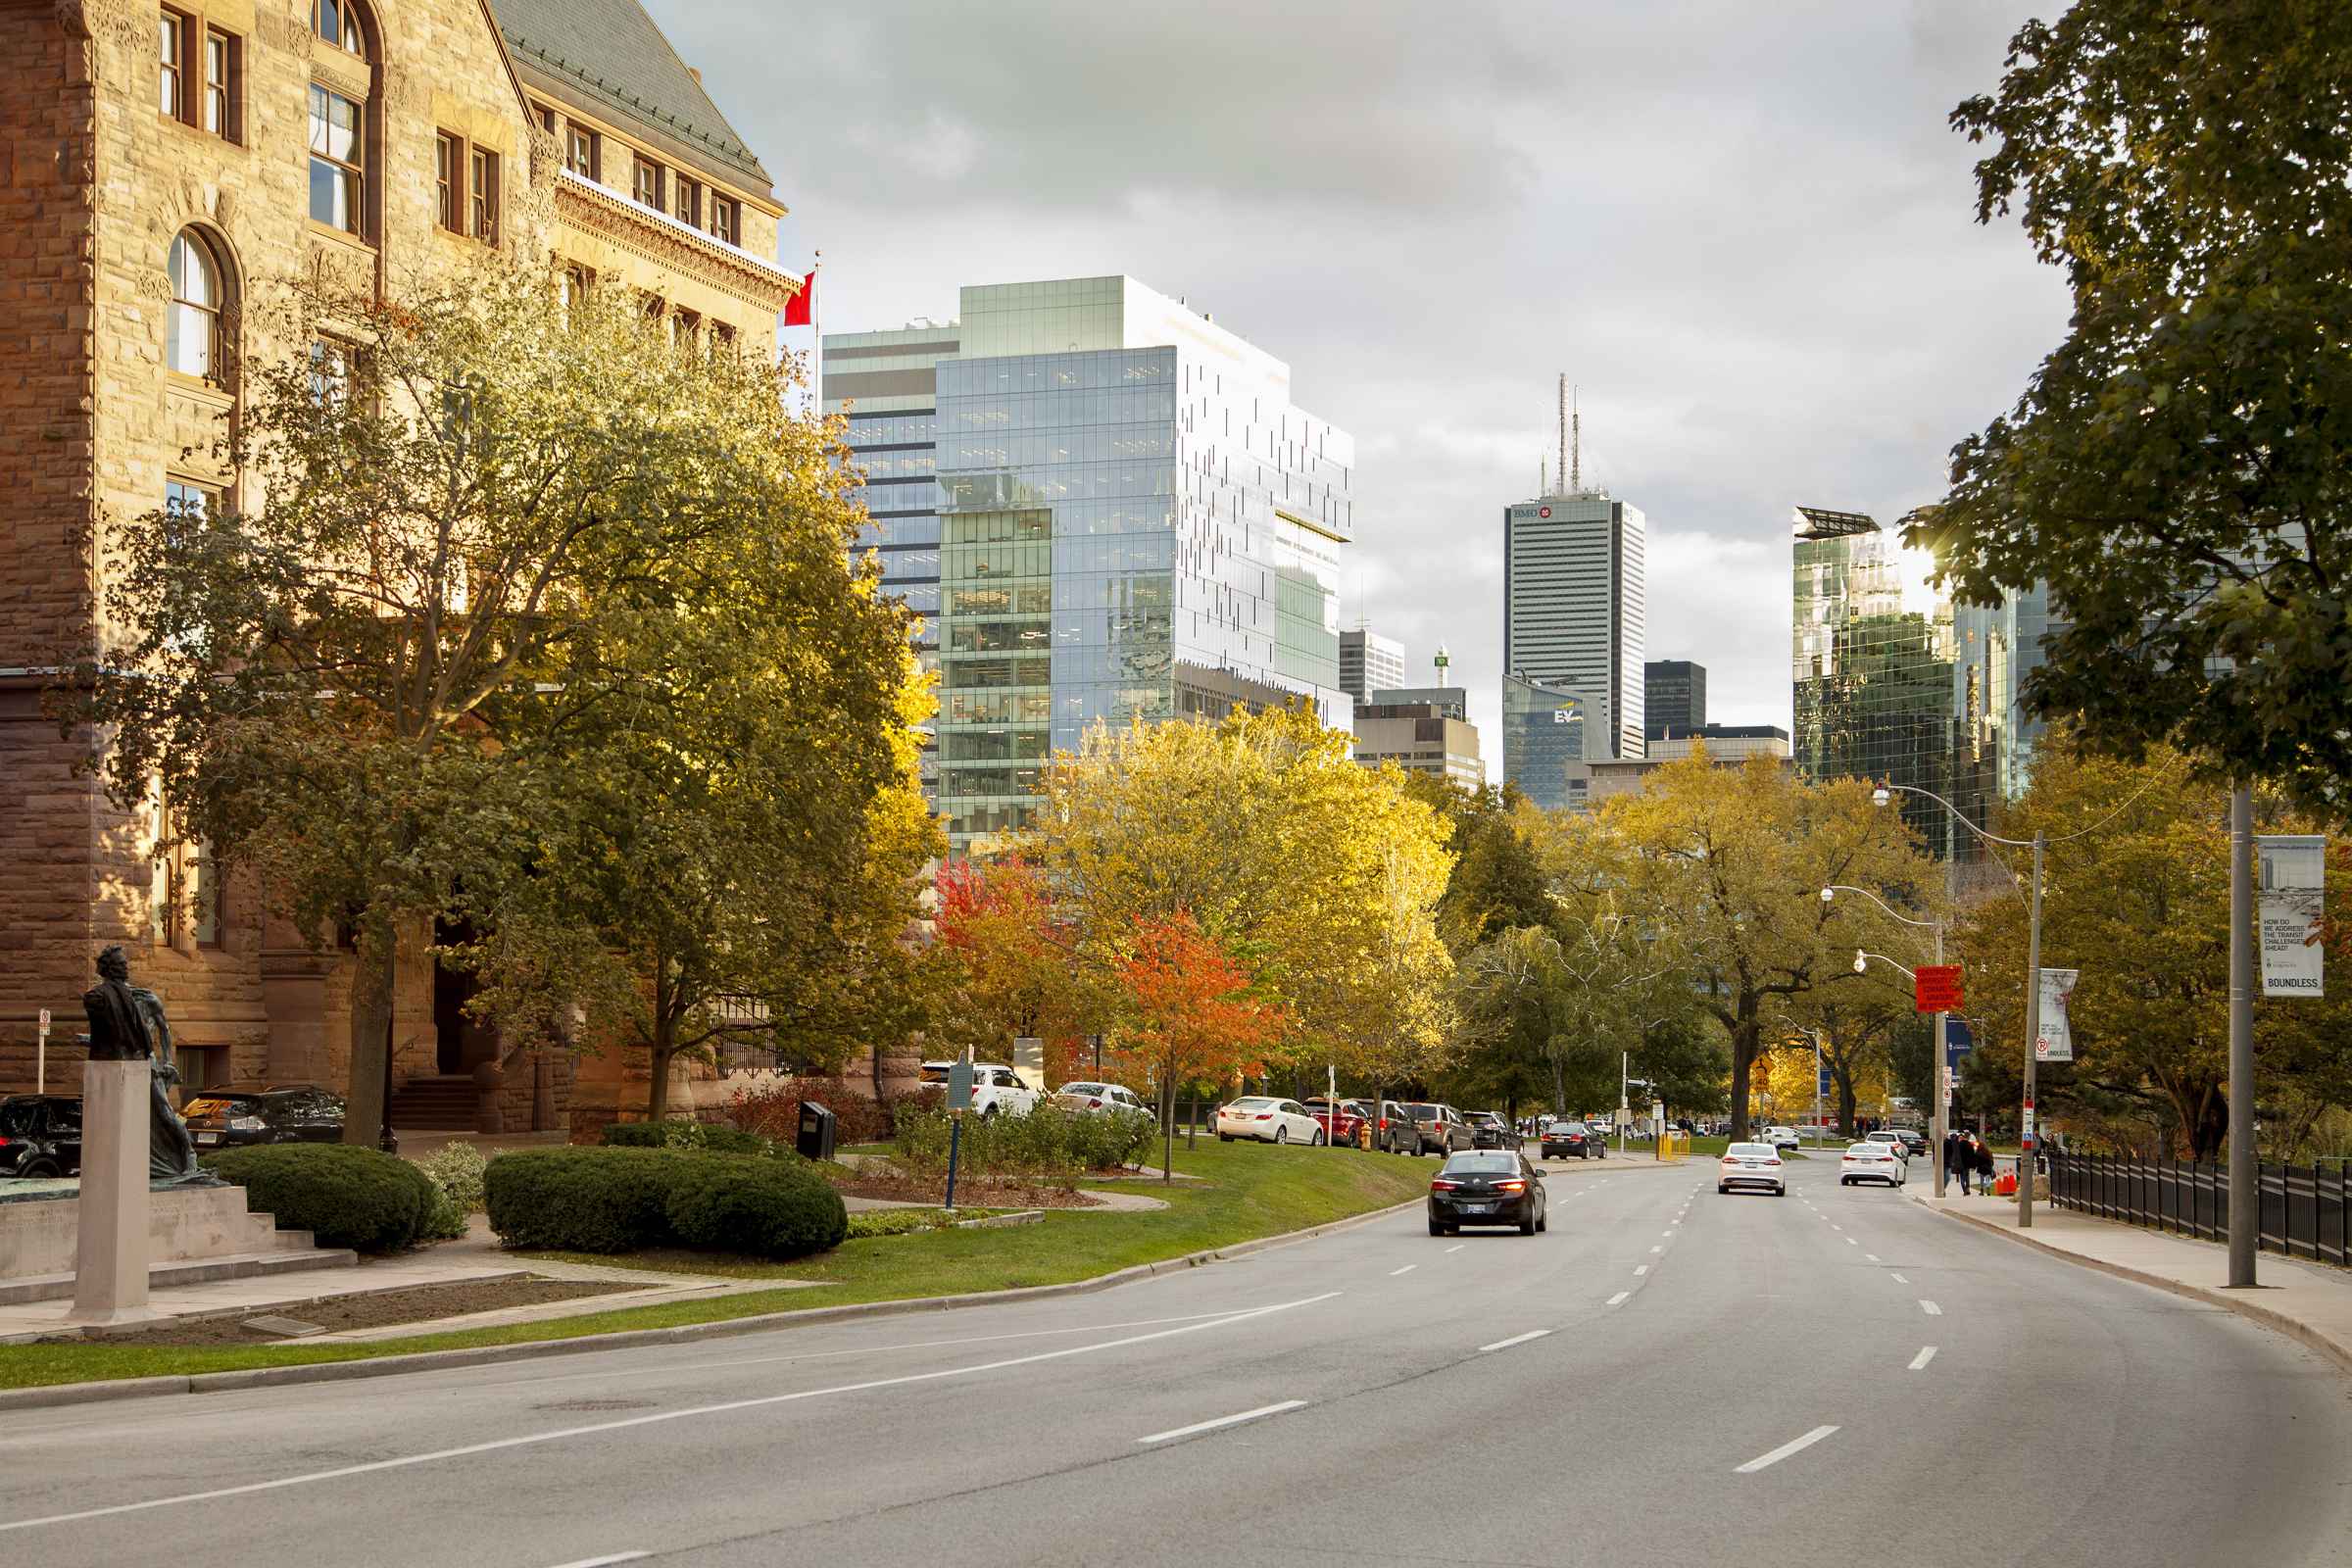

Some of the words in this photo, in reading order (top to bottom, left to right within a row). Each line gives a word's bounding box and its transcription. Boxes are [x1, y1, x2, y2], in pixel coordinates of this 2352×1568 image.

[1513, 510, 1538, 518] BMO
[1554, 710, 1573, 722] EY
[2268, 978, 2319, 988] BOUNDLESS
